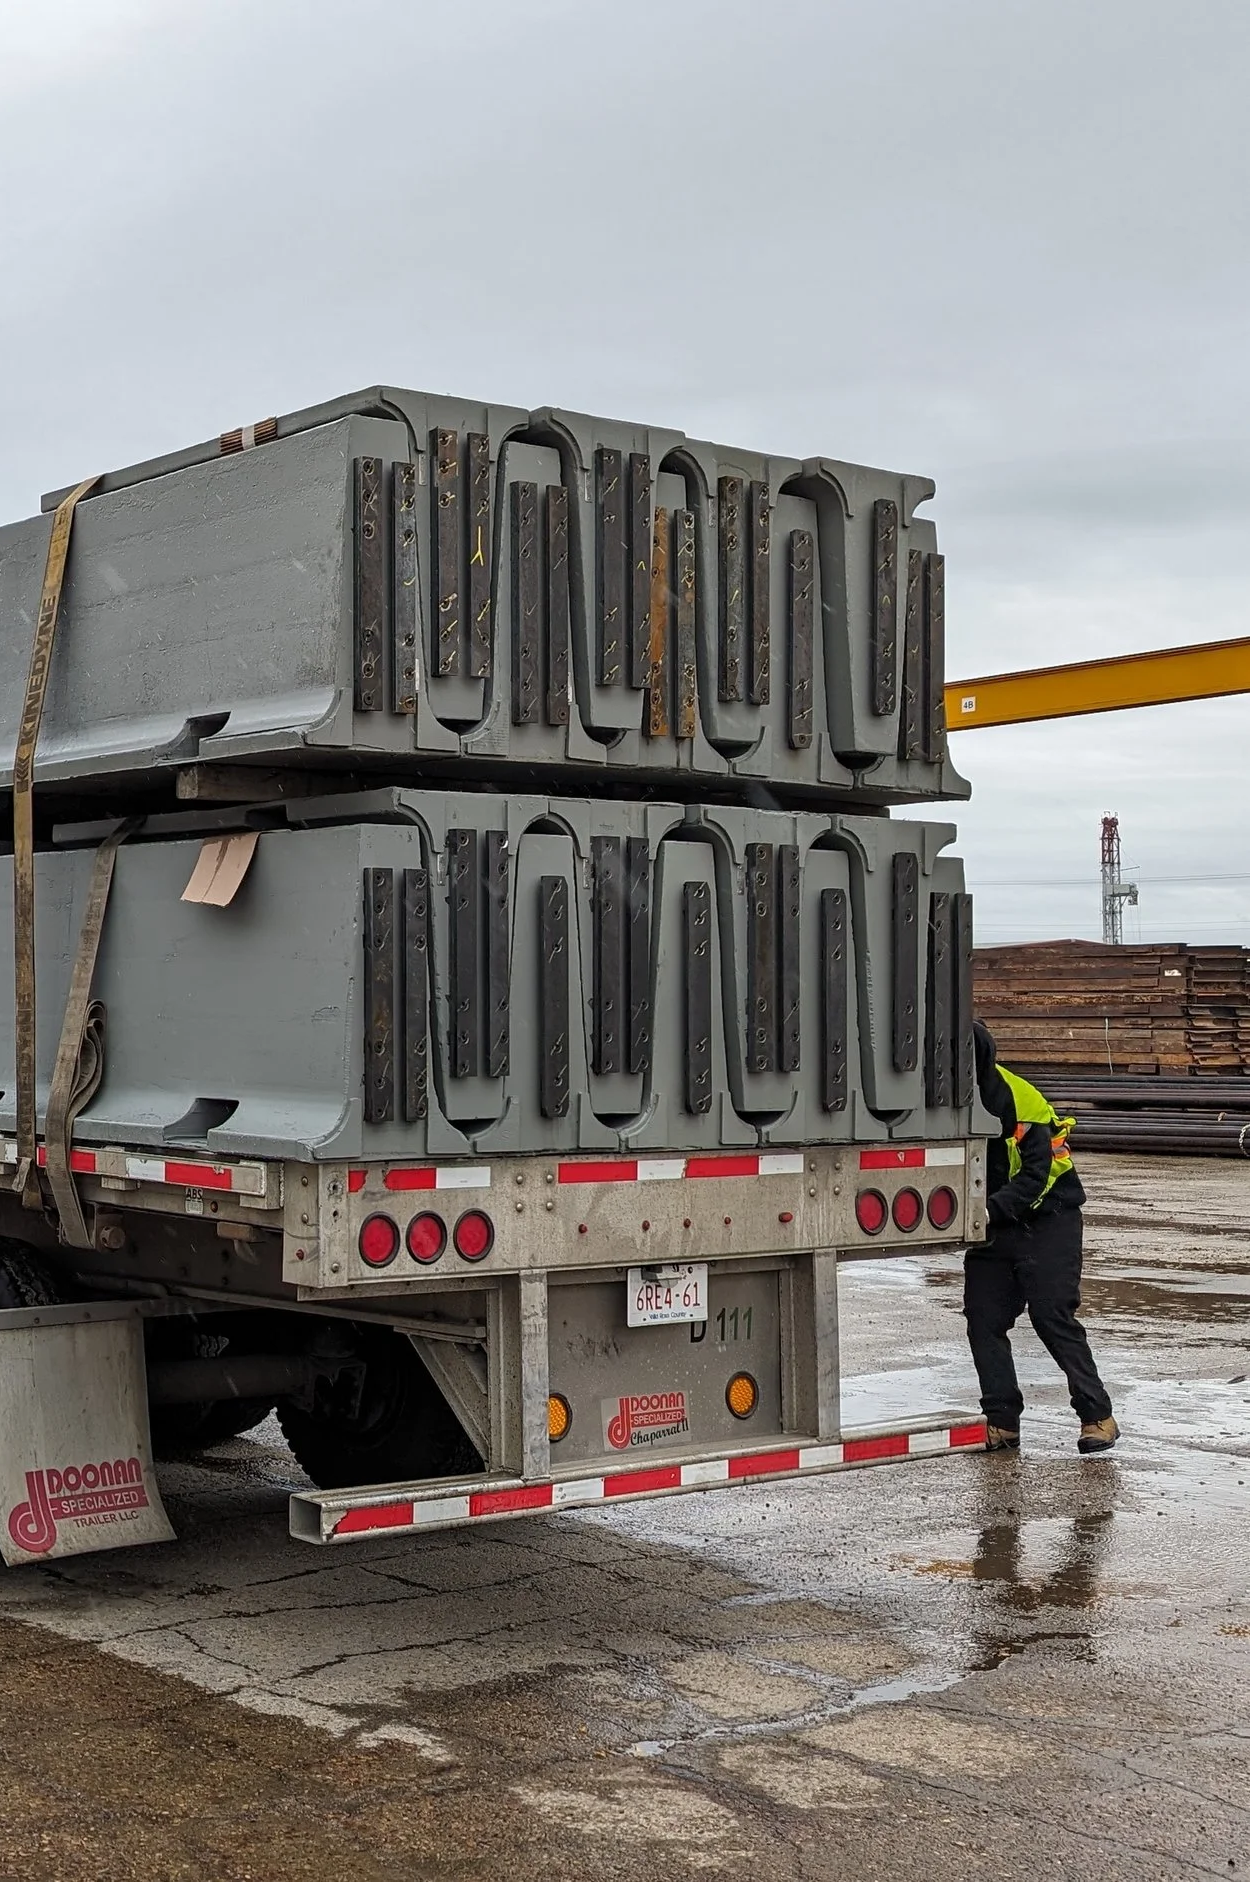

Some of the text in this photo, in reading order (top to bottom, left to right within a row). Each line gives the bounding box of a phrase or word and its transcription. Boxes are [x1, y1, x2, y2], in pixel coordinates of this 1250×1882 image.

[20, 596, 56, 746] KINEDYNE
[963, 701, 974, 709] 4B
[186, 1188, 203, 1200] ABS
[716, 1307, 752, 1341] 111
[631, 1392, 684, 1411] DOONAN
[633, 1411, 682, 1425] SPECIALIZED
[631, 1420, 682, 1446] Chaparral
[46, 1457, 142, 1494] DOONAN
[61, 1491, 139, 1514] SPECIALIZED
[73, 1510, 139, 1528] TRAILER LLC
